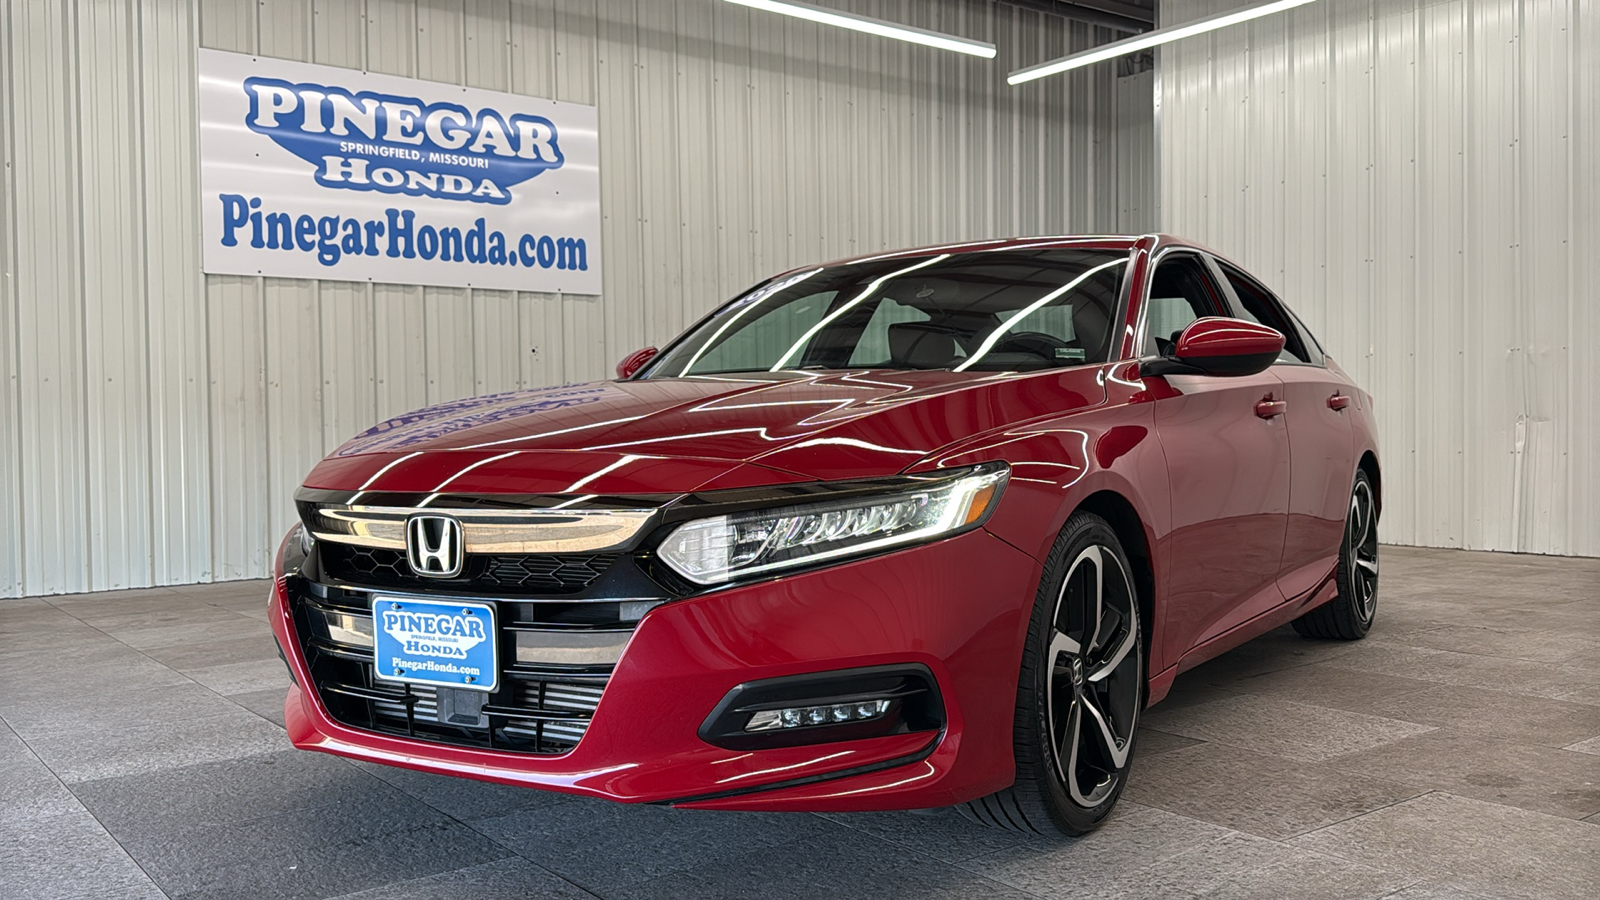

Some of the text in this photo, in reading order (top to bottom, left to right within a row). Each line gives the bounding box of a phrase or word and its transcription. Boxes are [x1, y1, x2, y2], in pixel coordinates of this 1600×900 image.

[251, 84, 560, 163] PINEGAR
[339, 141, 489, 169] SPRINGFIELD, MISSOURI
[321, 155, 506, 199] HONDA
[218, 193, 589, 272] PinegarHonda.com
[385, 613, 484, 639] PINEGAR
[405, 640, 465, 656] HONDA
[391, 657, 481, 676] PinegarHonda.com
